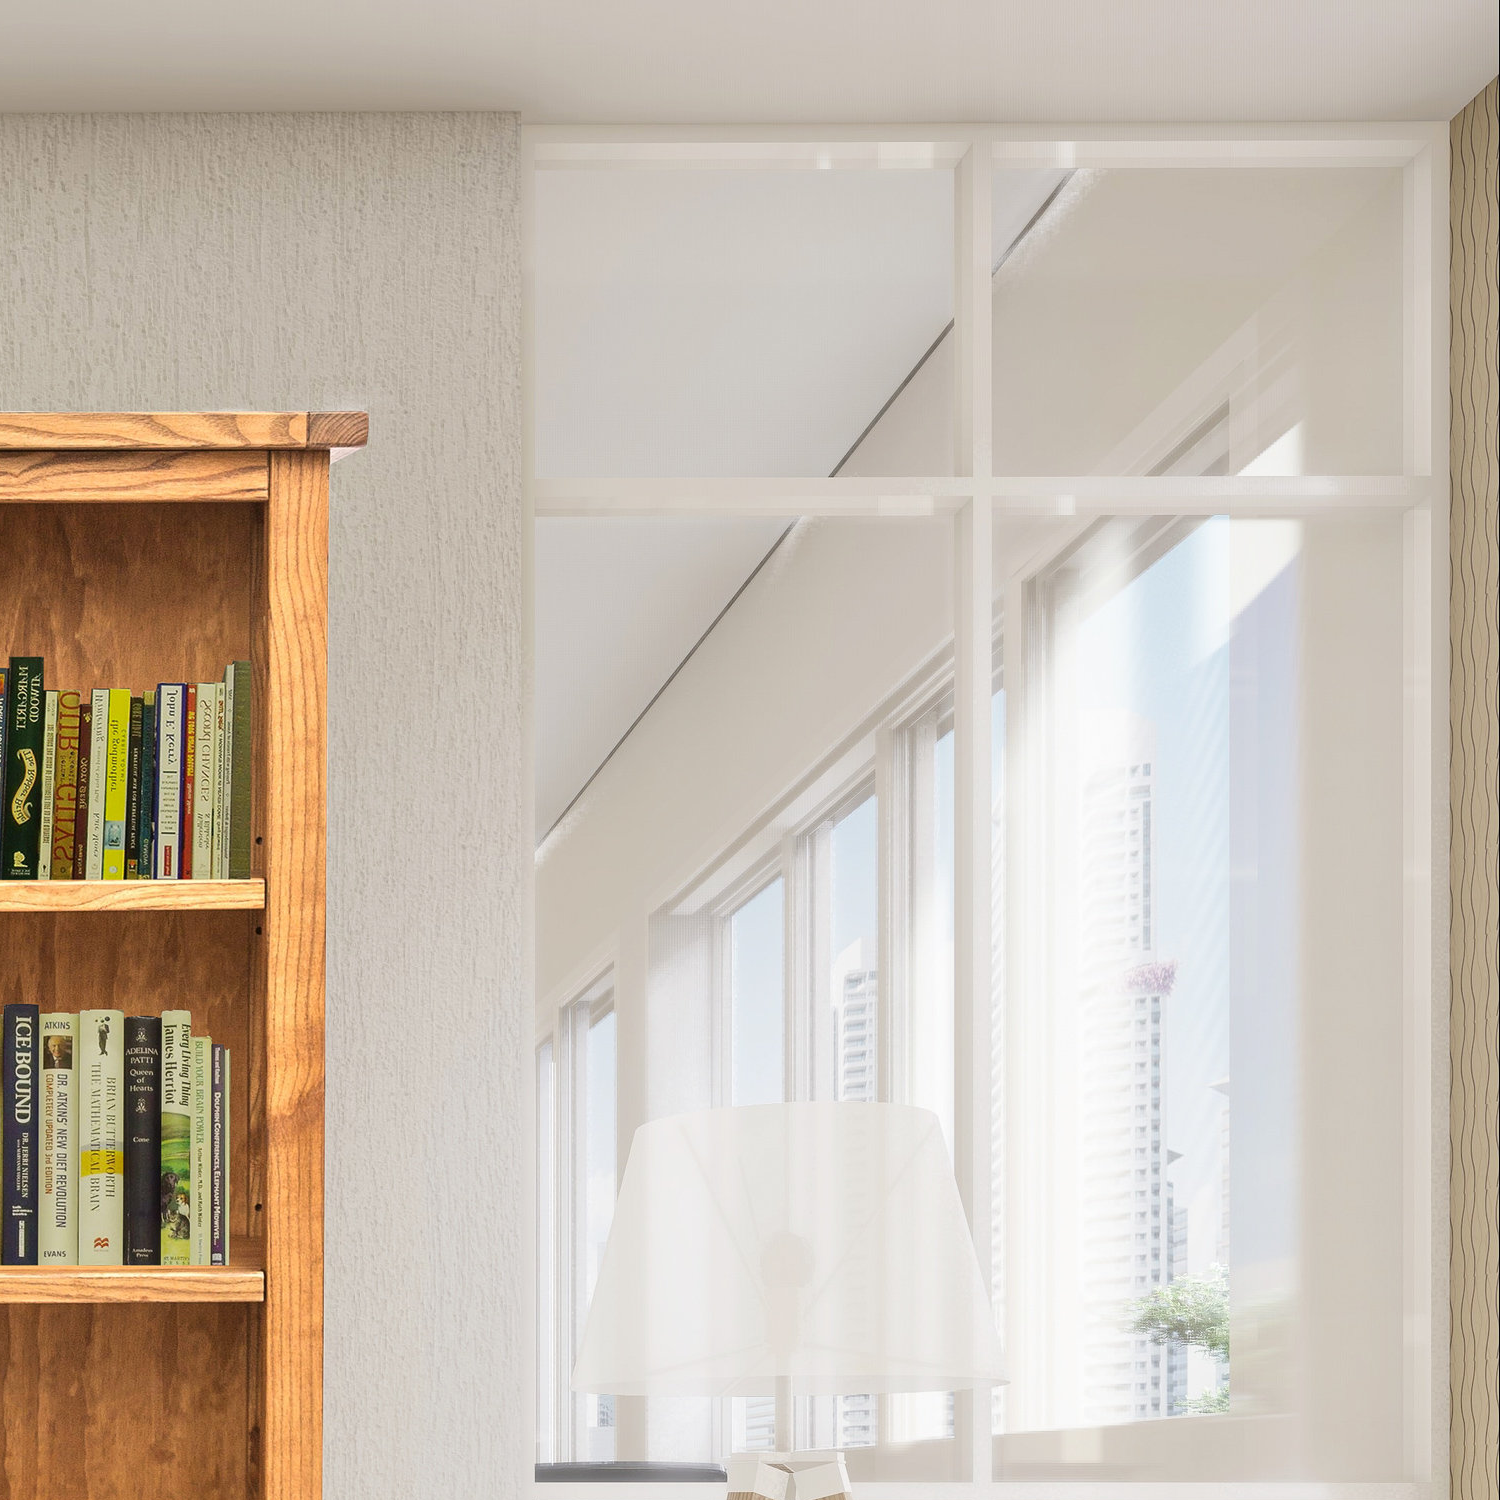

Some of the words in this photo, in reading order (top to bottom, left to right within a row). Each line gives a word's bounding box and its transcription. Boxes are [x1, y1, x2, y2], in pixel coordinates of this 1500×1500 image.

[16, 1016, 32, 1049] ICE
[44, 1021, 71, 1030] ATKINS
[180, 1024, 191, 1048] Every
[125, 1048, 159, 1056] ADELINA
[164, 1024, 176, 1060] James
[195, 1040, 204, 1064] BUILD
[130, 1056, 154, 1064] PATTI
[180, 1050, 191, 1080] Living
[56, 1074, 68, 1088] DR.
[90, 1062, 102, 1086] THE
[130, 1069, 154, 1078] Queen
[164, 1062, 177, 1105] Herriot
[195, 1066, 204, 1088] YOUR
[14, 1050, 32, 1124] BOUND
[45, 1074, 54, 1117] COMPLETELY
[105, 1077, 116, 1110] BRIAN
[180, 1081, 191, 1106] Thing
[196, 1089, 204, 1114] BRAIN
[45, 1119, 54, 1151] UPDATED
[56, 1128, 67, 1149] NEW
[90, 1089, 101, 1176] MATHEMATICAL
[196, 1116, 204, 1144] POWER
[45, 1153, 53, 1164] 3rd
[56, 1153, 67, 1172] DIET
[105, 1114, 116, 1198] BUTTERWORTH
[44, 1166, 53, 1194] EDITION
[56, 1174, 67, 1228] REVOLUTION
[89, 1177, 100, 1212] BRAIN
